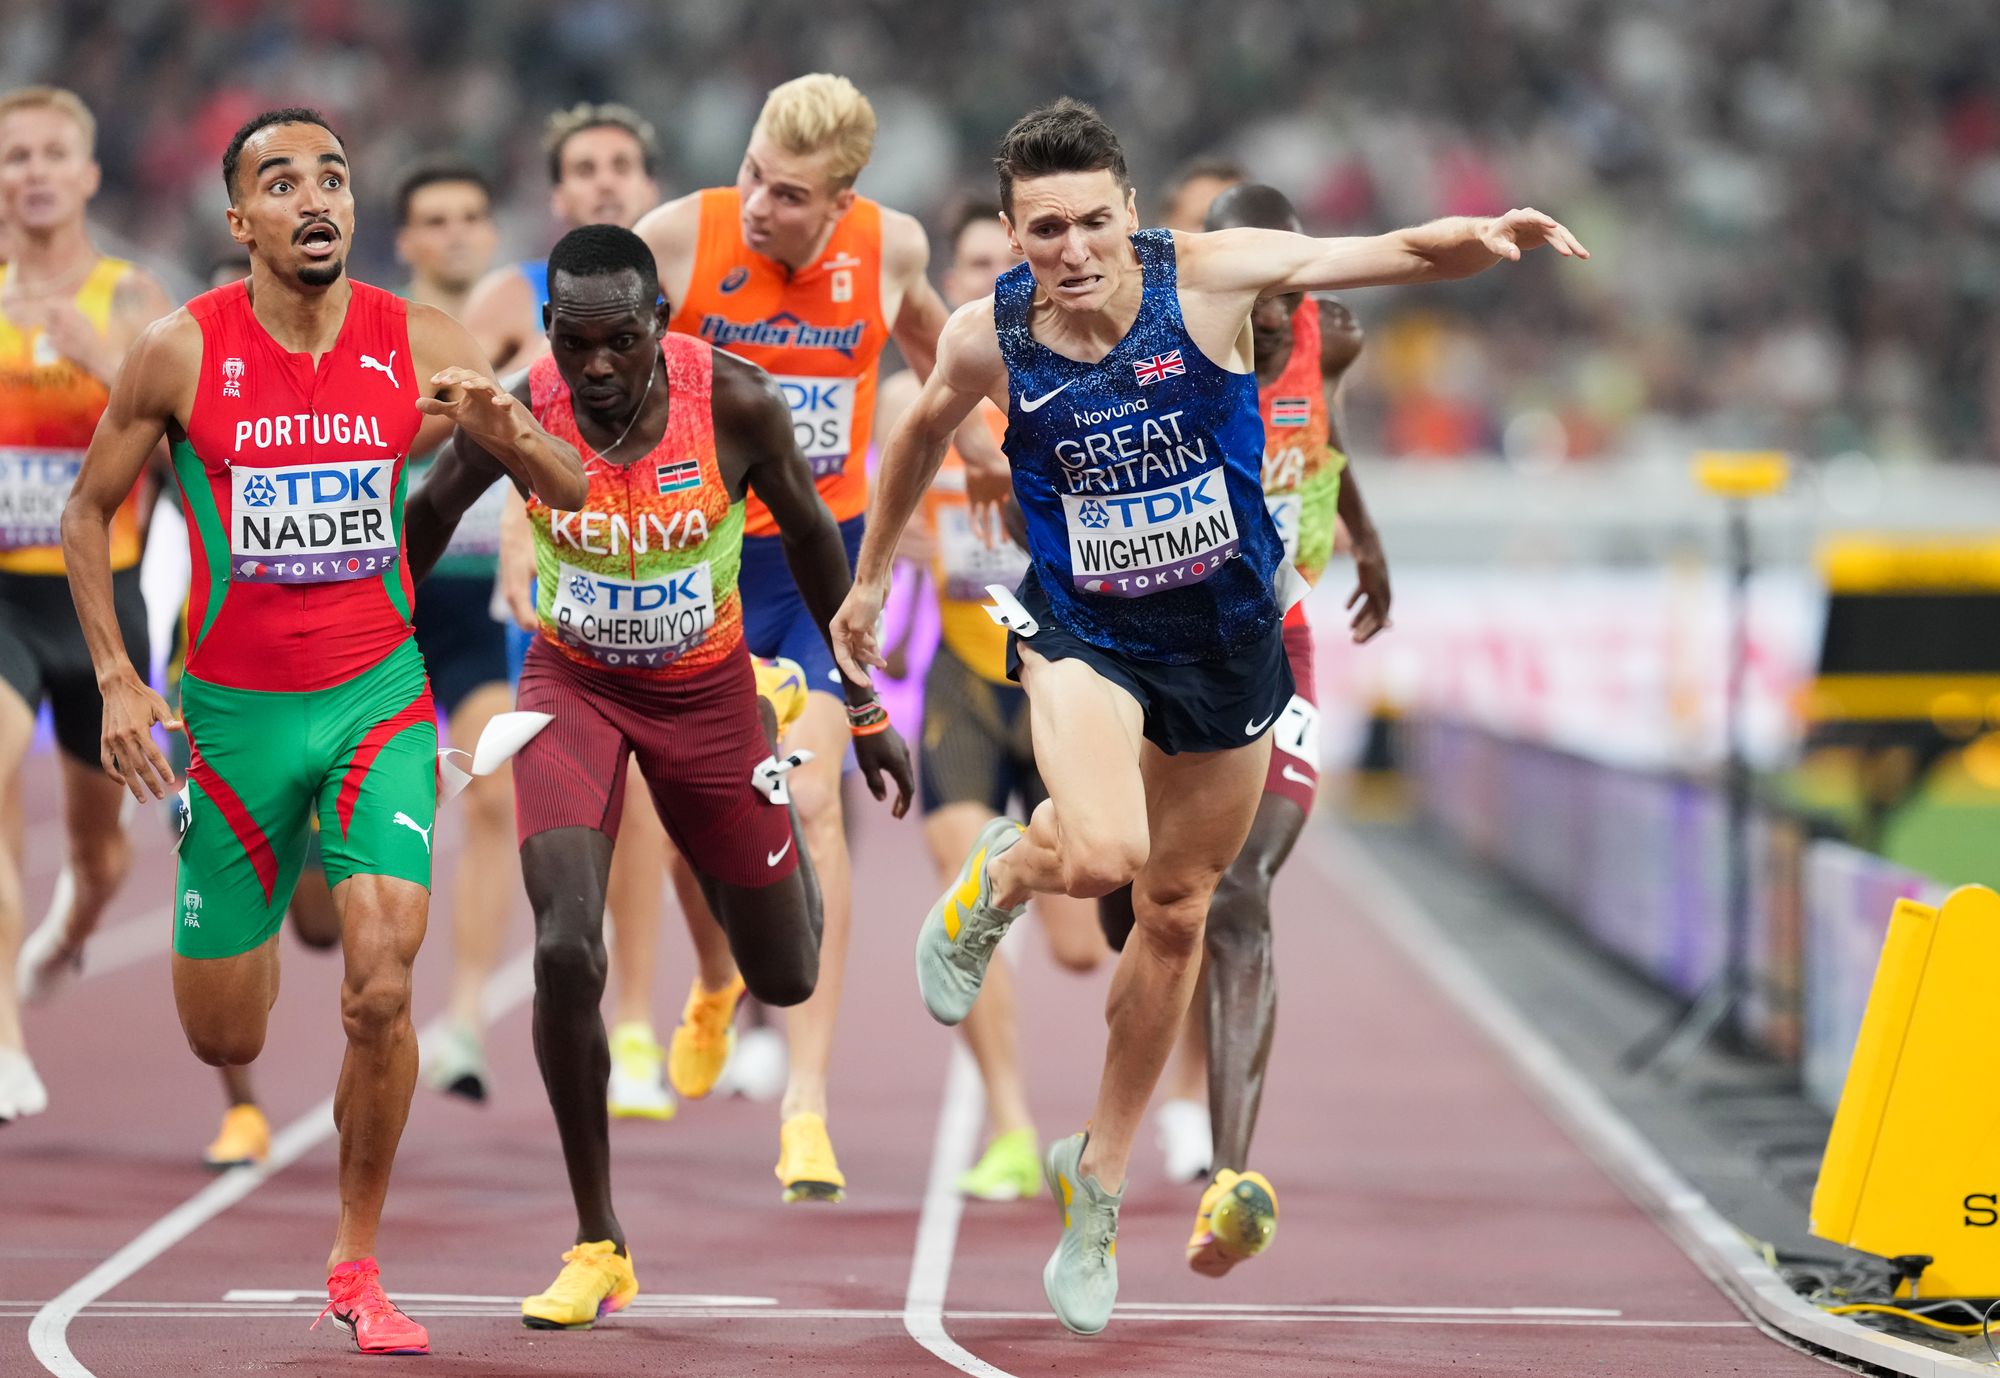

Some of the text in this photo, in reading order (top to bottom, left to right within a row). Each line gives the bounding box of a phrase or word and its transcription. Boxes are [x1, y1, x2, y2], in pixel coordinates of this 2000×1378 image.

[700, 314, 866, 348] Nederland
[223, 387, 241, 398] FPA
[779, 384, 842, 412] DK
[235, 413, 388, 452] PORTUGAL
[1074, 398, 1148, 428] Novuna
[1055, 410, 1183, 469] GREAT
[276, 466, 381, 505] TDK
[1063, 438, 1207, 493] BRITAIN
[1107, 475, 1217, 528] TDK
[243, 508, 385, 550] NADER
[551, 509, 709, 555] KENYA
[1077, 510, 1230, 571] WIGHTMAN
[597, 571, 699, 611] TDK
[581, 605, 706, 645] CHERUIYOT
[184, 918, 200, 929] FPA
